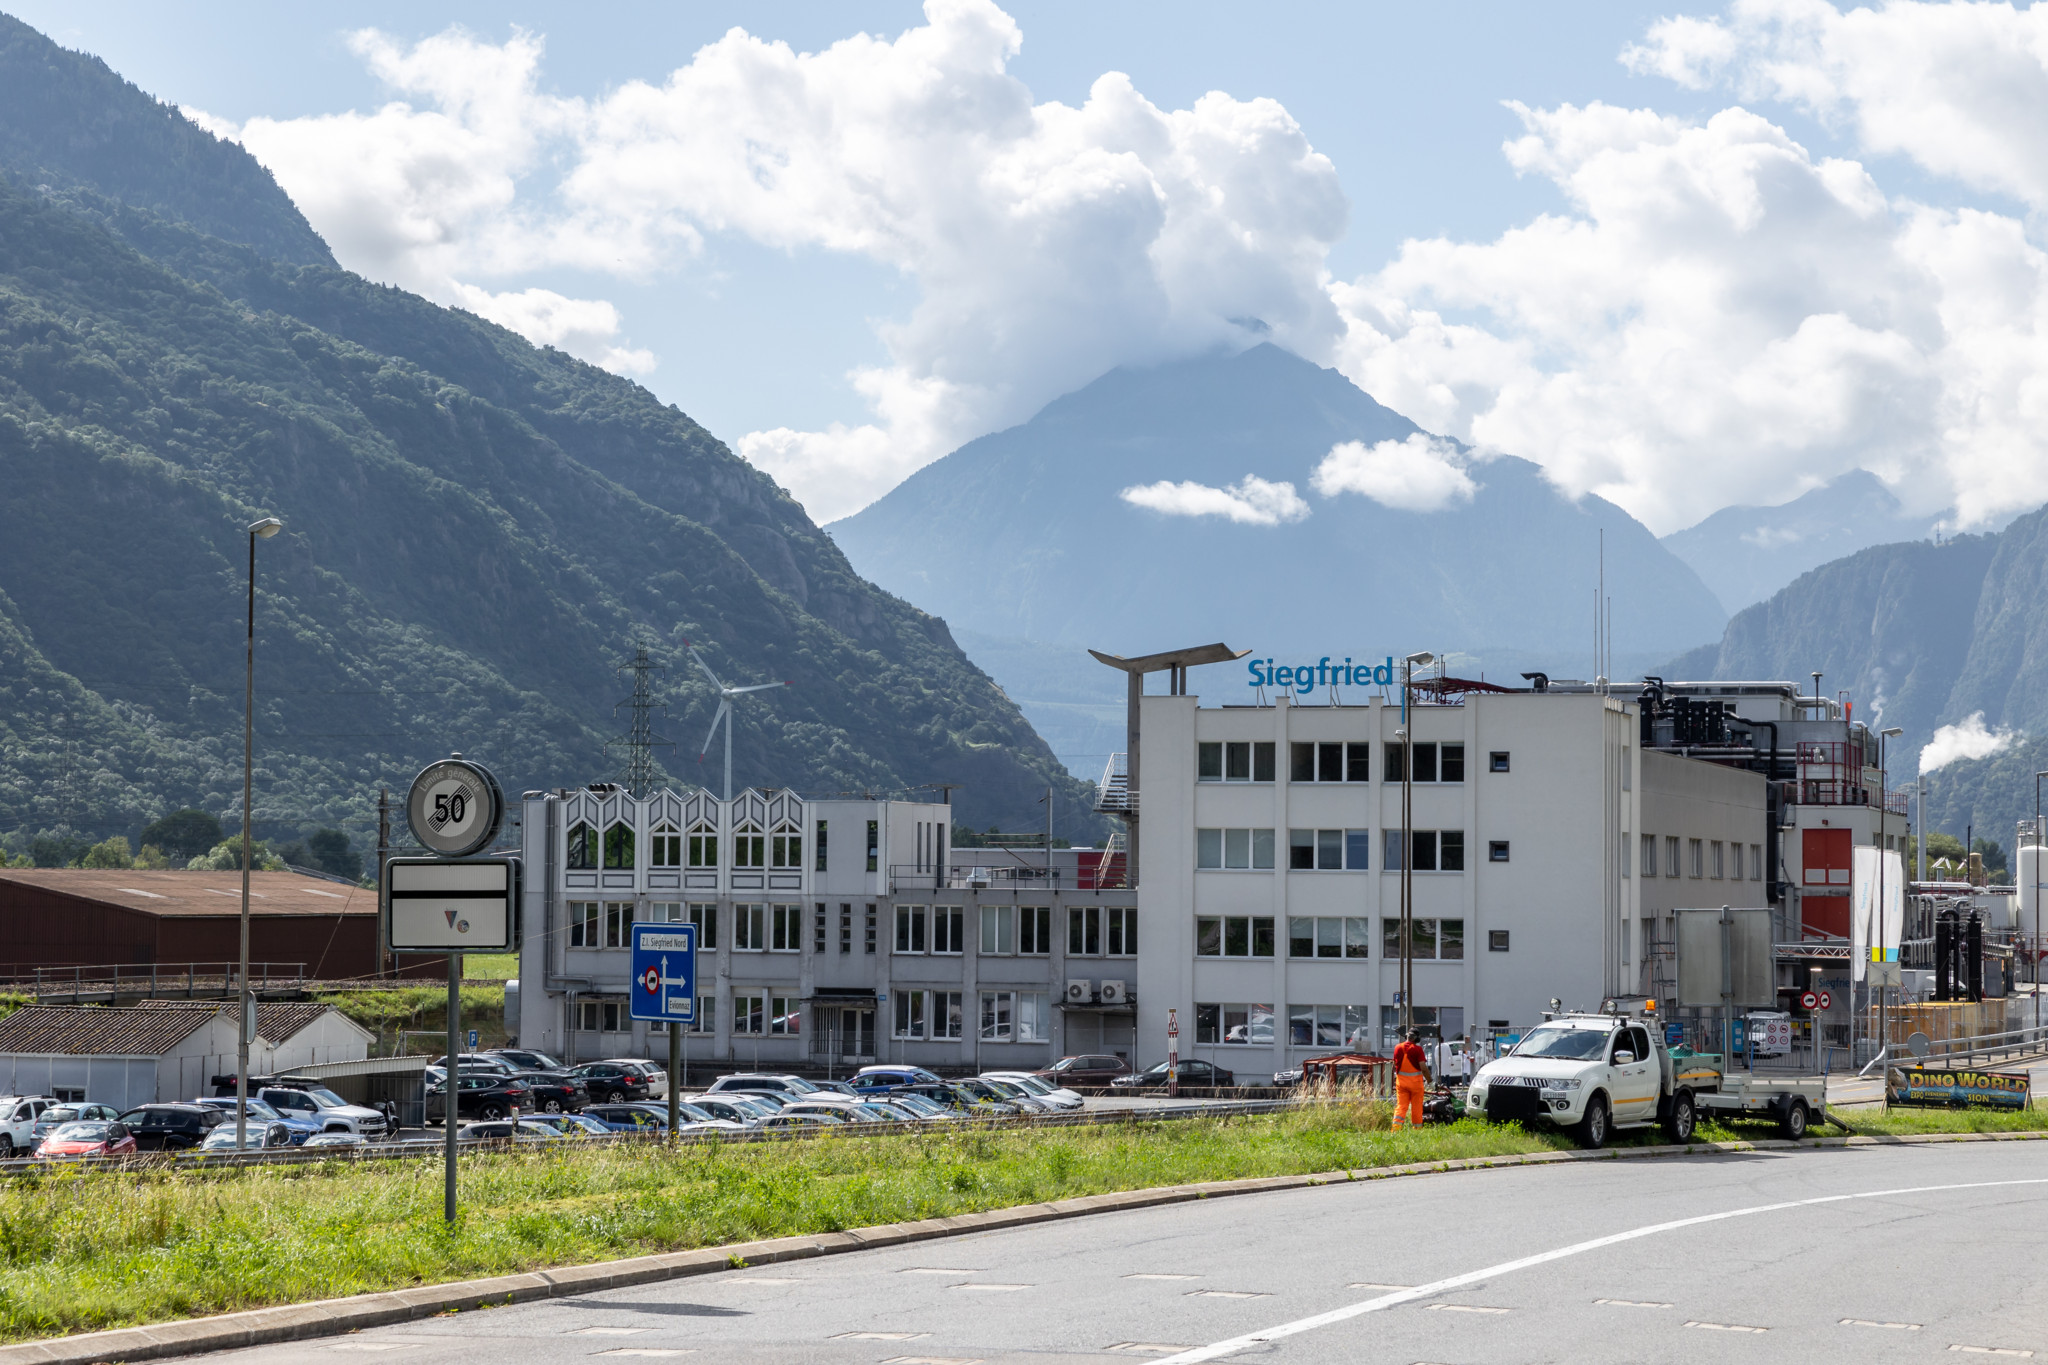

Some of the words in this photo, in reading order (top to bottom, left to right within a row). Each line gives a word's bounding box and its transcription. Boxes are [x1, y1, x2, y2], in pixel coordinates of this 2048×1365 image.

[1248, 656, 1393, 694] Siegfried
[419, 771, 444, 792] Limite
[447, 769, 480, 792] générale
[435, 794, 466, 823] 50
[651, 938, 673, 949] Siegfried
[674, 938, 686, 948] Nord
[1818, 977, 1855, 990] Siegfrie
[669, 1000, 690, 1011] Evionnaz
[1909, 1072, 1955, 1088] DINO
[1956, 1072, 2027, 1093] WORLD
[1910, 1090, 1924, 1100] EXPO
[1967, 1094, 1990, 1103] SION
